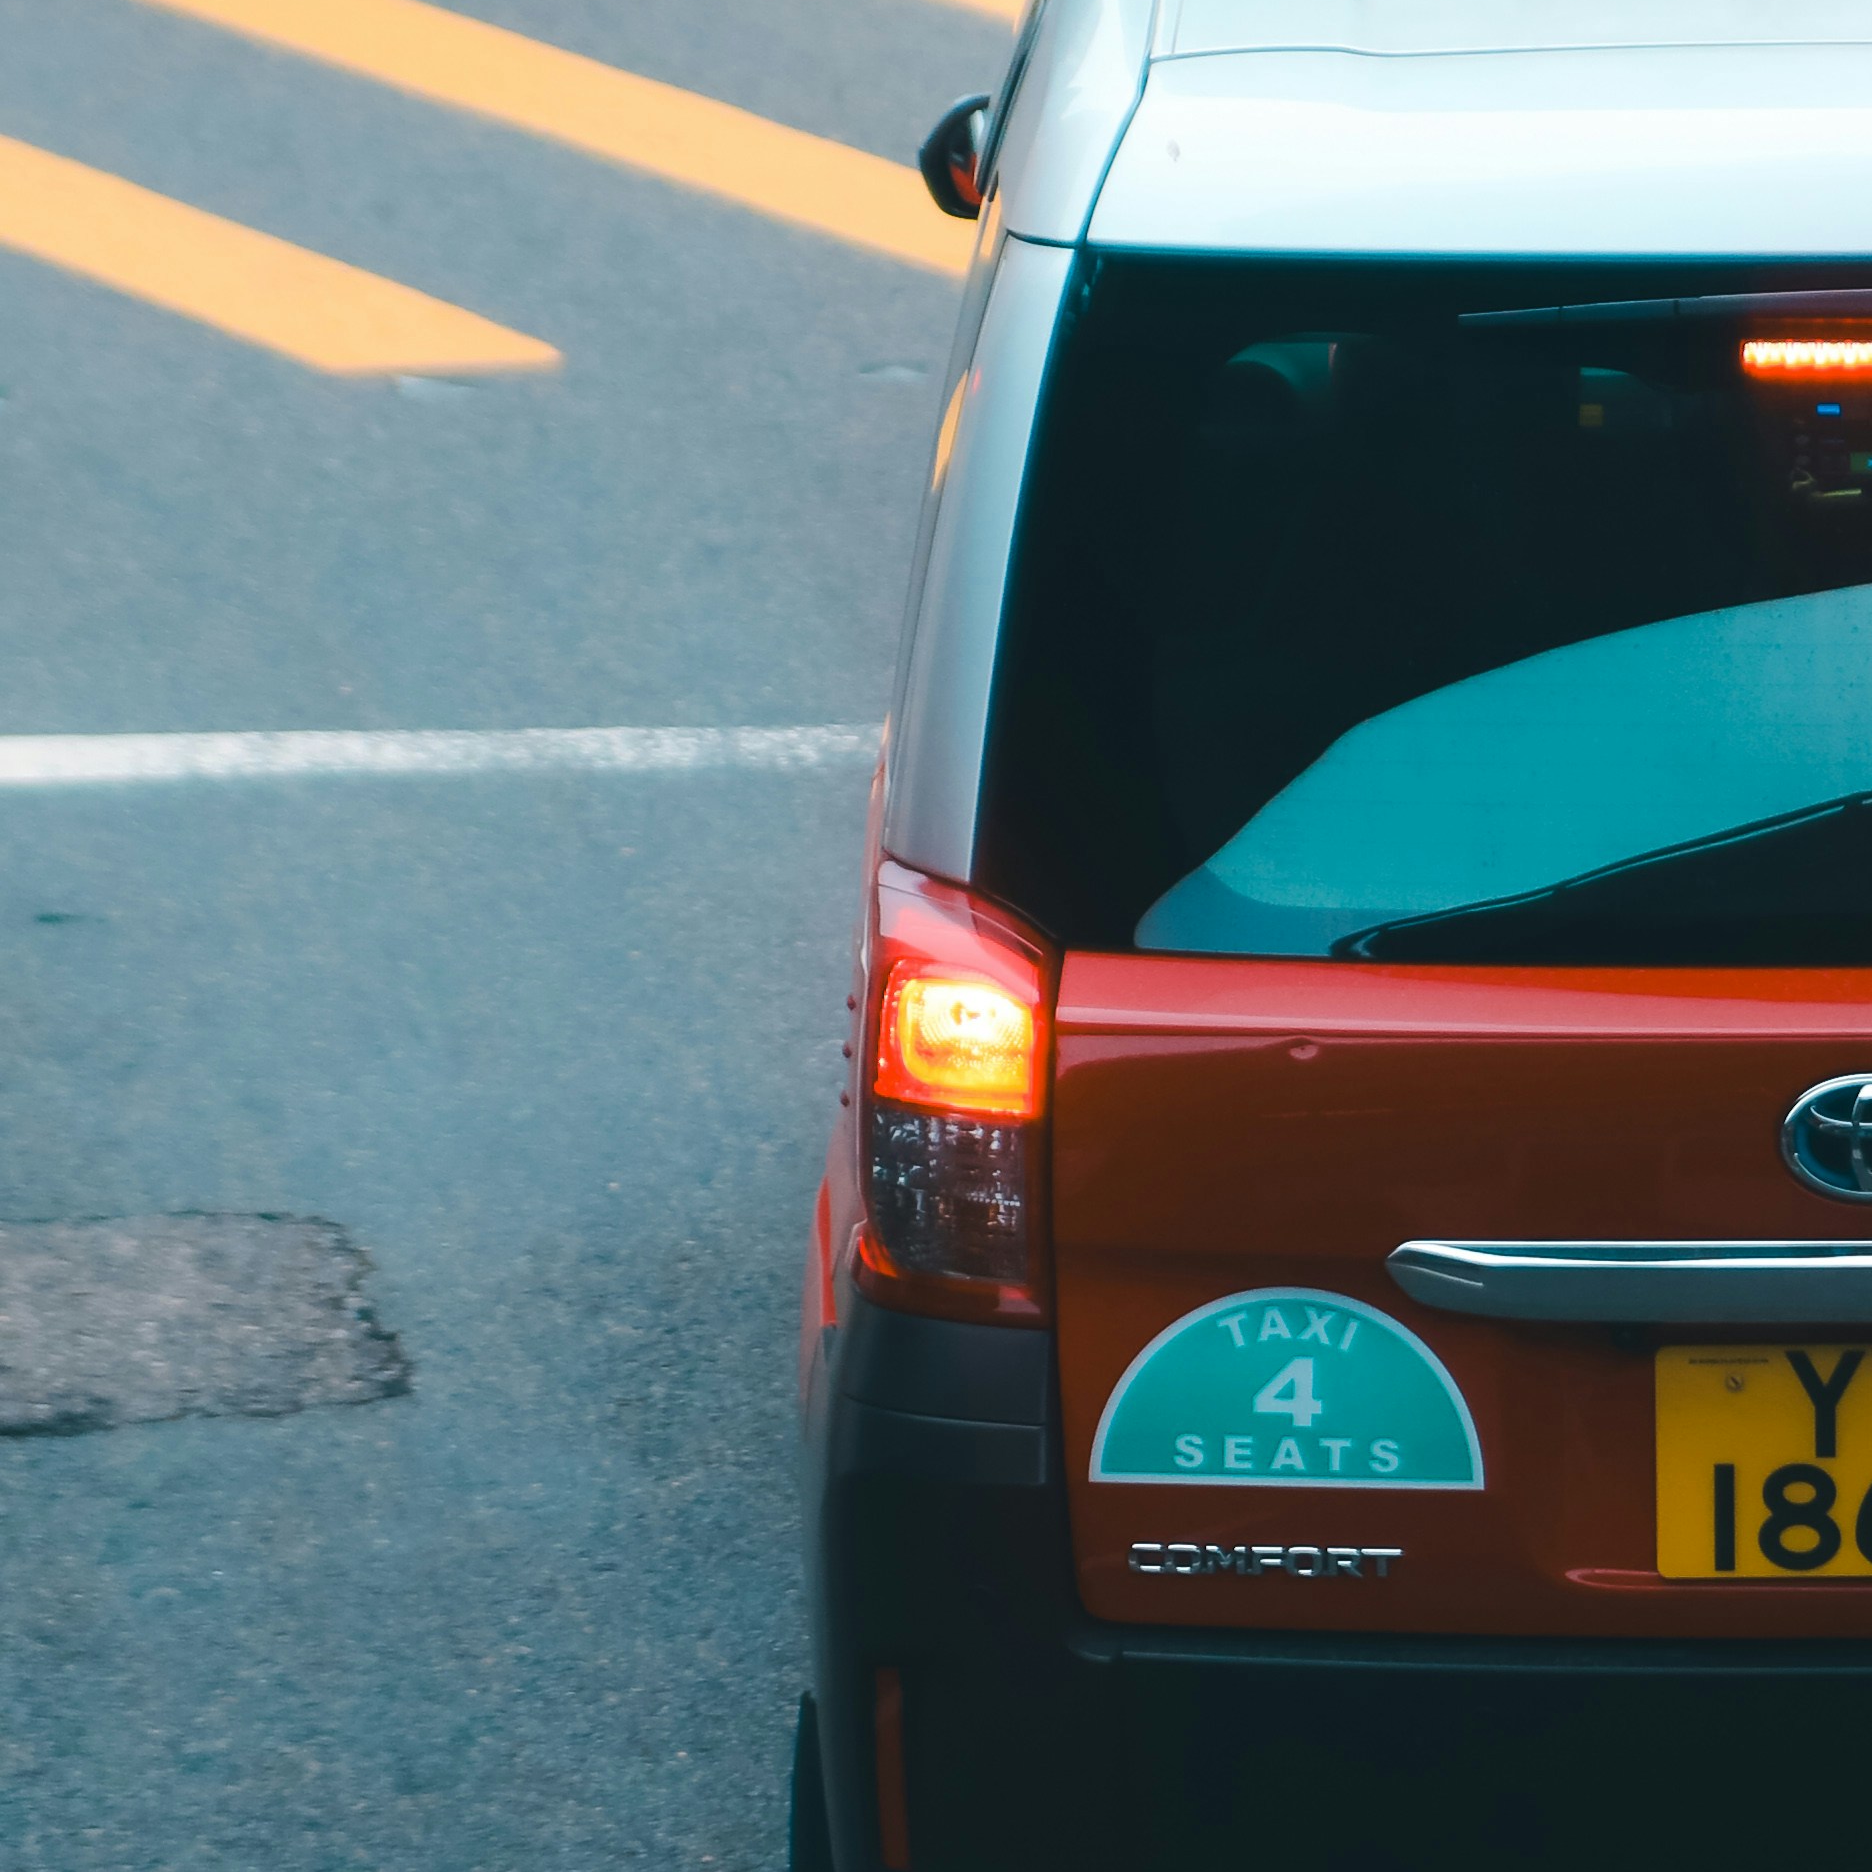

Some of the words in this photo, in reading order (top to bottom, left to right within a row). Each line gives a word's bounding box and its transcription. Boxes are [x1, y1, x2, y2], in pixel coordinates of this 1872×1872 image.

[1217, 1305, 1361, 1352] TAXI
[1252, 1355, 1323, 1428] 4
[1173, 1433, 1401, 1473] SEATS
[1129, 1542, 1404, 1577] COMFORT
